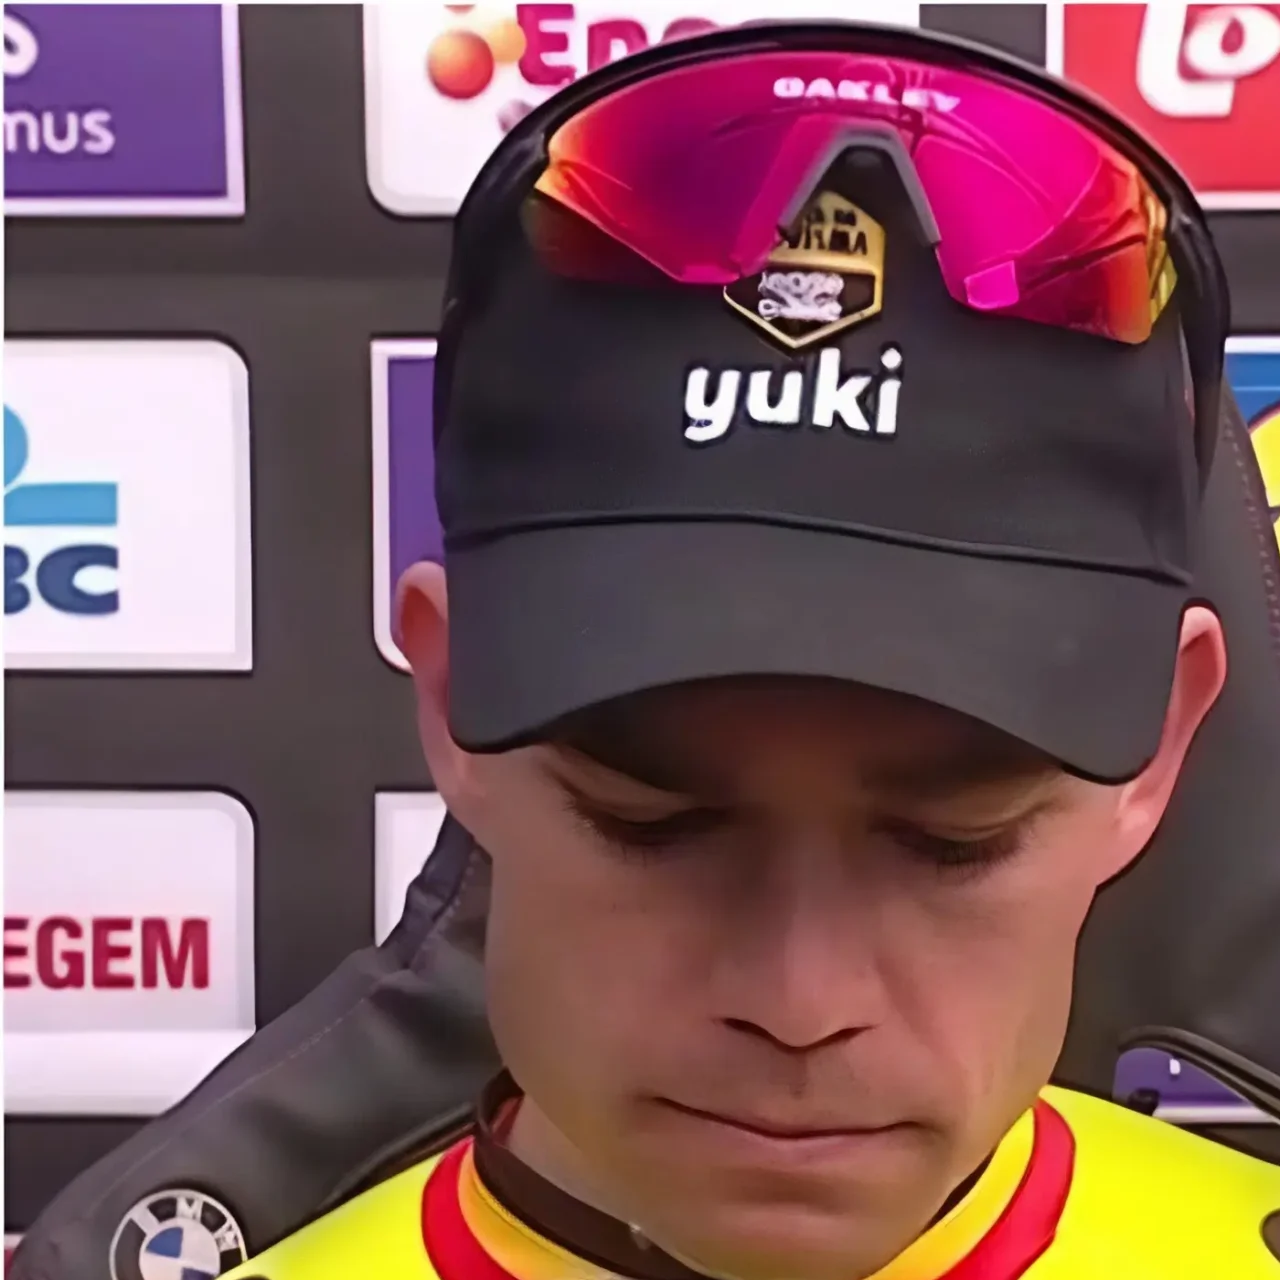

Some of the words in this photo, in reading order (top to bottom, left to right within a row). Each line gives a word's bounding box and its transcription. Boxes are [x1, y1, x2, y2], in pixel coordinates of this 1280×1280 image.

[773, 76, 961, 112] OAKLEY
[684, 347, 902, 442] yuki
[4, 916, 209, 991] EGEM
